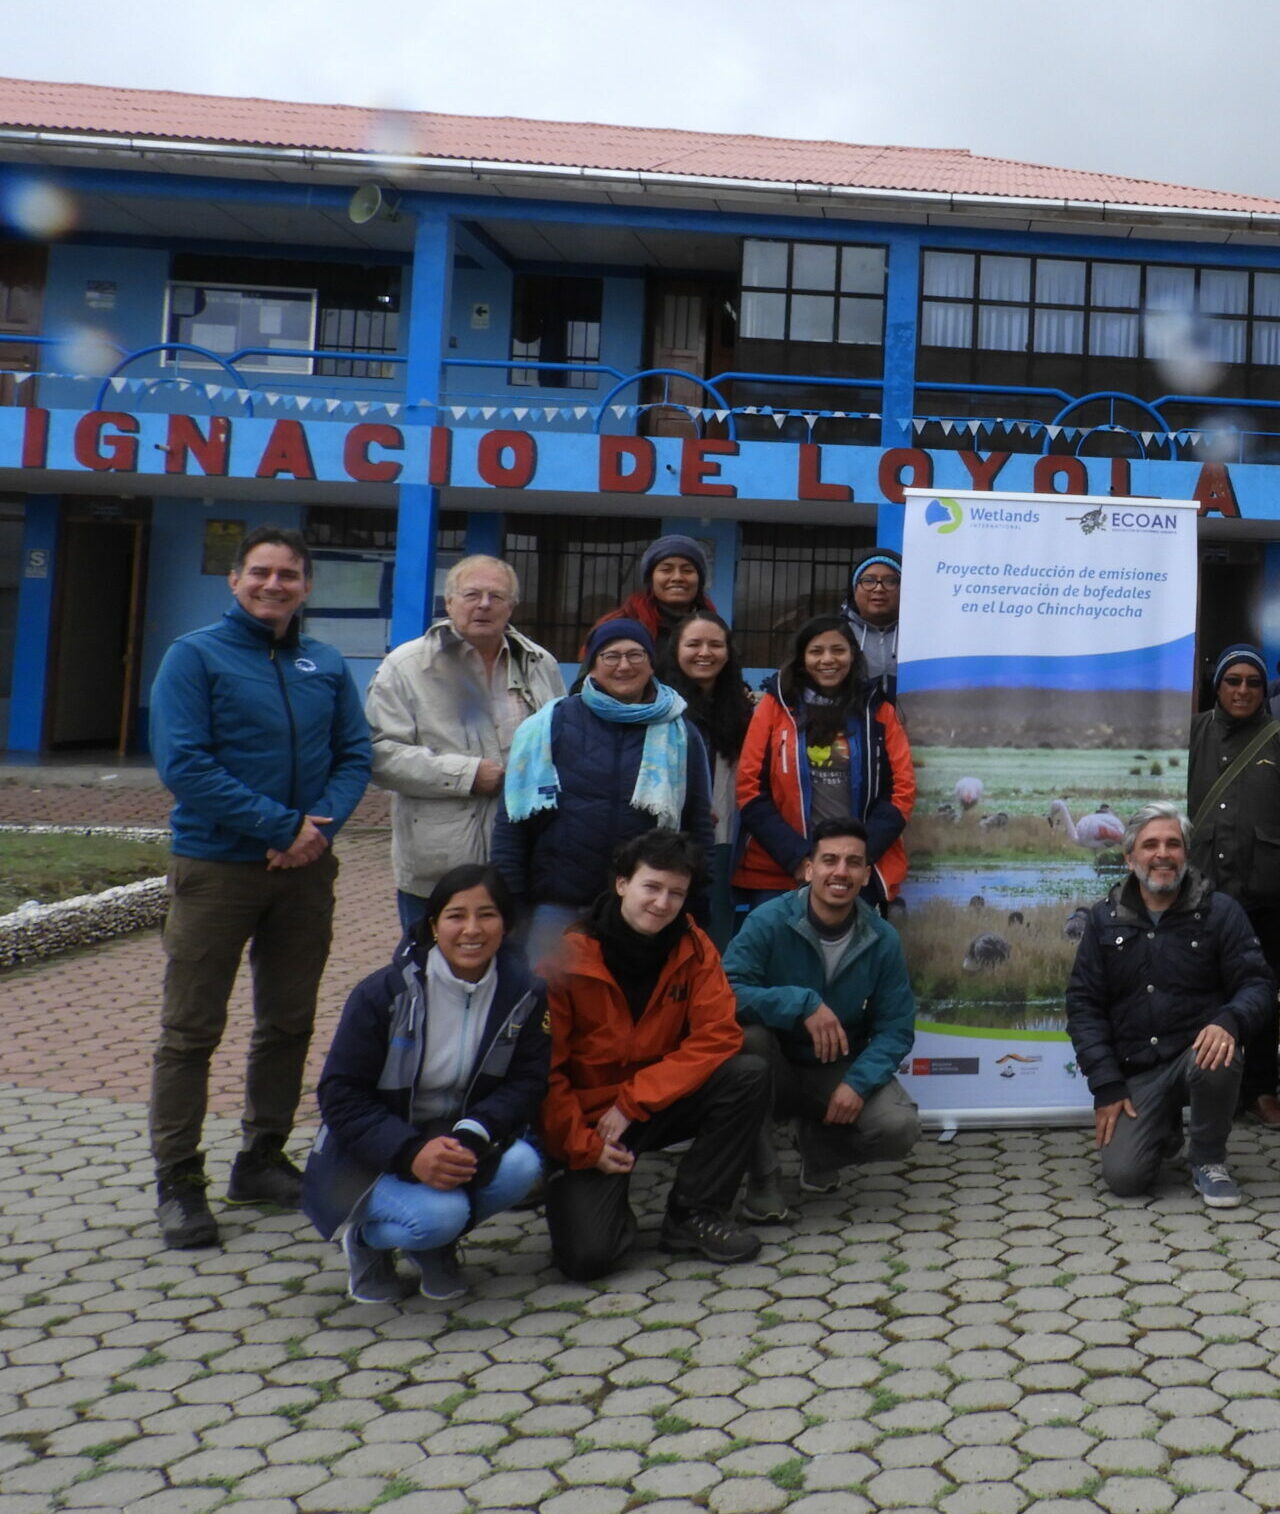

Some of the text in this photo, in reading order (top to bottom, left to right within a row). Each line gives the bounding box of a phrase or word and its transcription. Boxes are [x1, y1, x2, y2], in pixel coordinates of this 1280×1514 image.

[22, 407, 537, 488] IGNACIO
[599, 435, 740, 499] DE
[970, 507, 1040, 523] Wetlands
[1112, 512, 1177, 529] ECOAN
[936, 561, 1168, 582] Proyecto Reducción de emisiones
[952, 582, 1151, 601] y conservación de bofedales
[961, 601, 1143, 620] en el Lago Chinchaycocha
